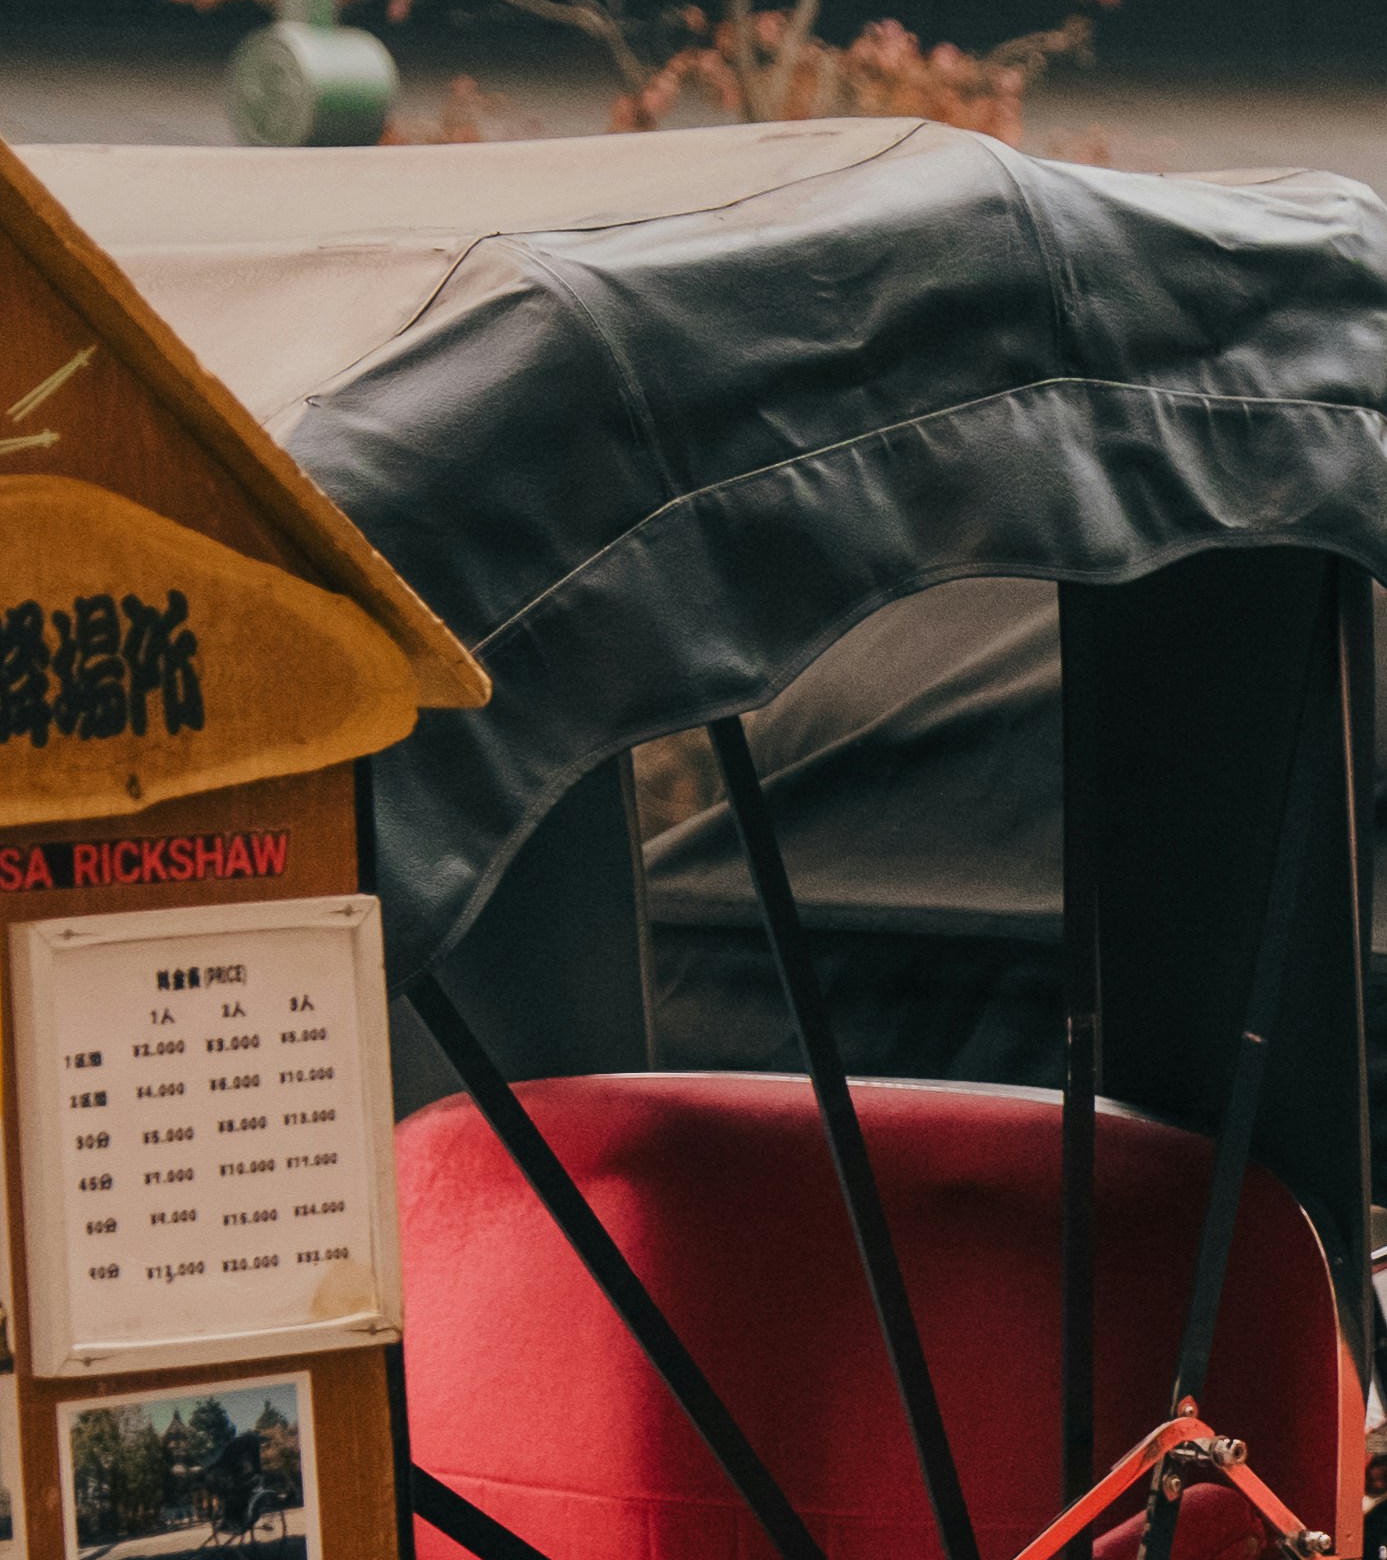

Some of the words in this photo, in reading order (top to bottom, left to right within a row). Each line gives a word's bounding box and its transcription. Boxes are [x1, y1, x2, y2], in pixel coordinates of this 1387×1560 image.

[0, 846, 53, 889] SA
[73, 835, 287, 885] RICKSHAW
[151, 1009, 174, 1024] 1人
